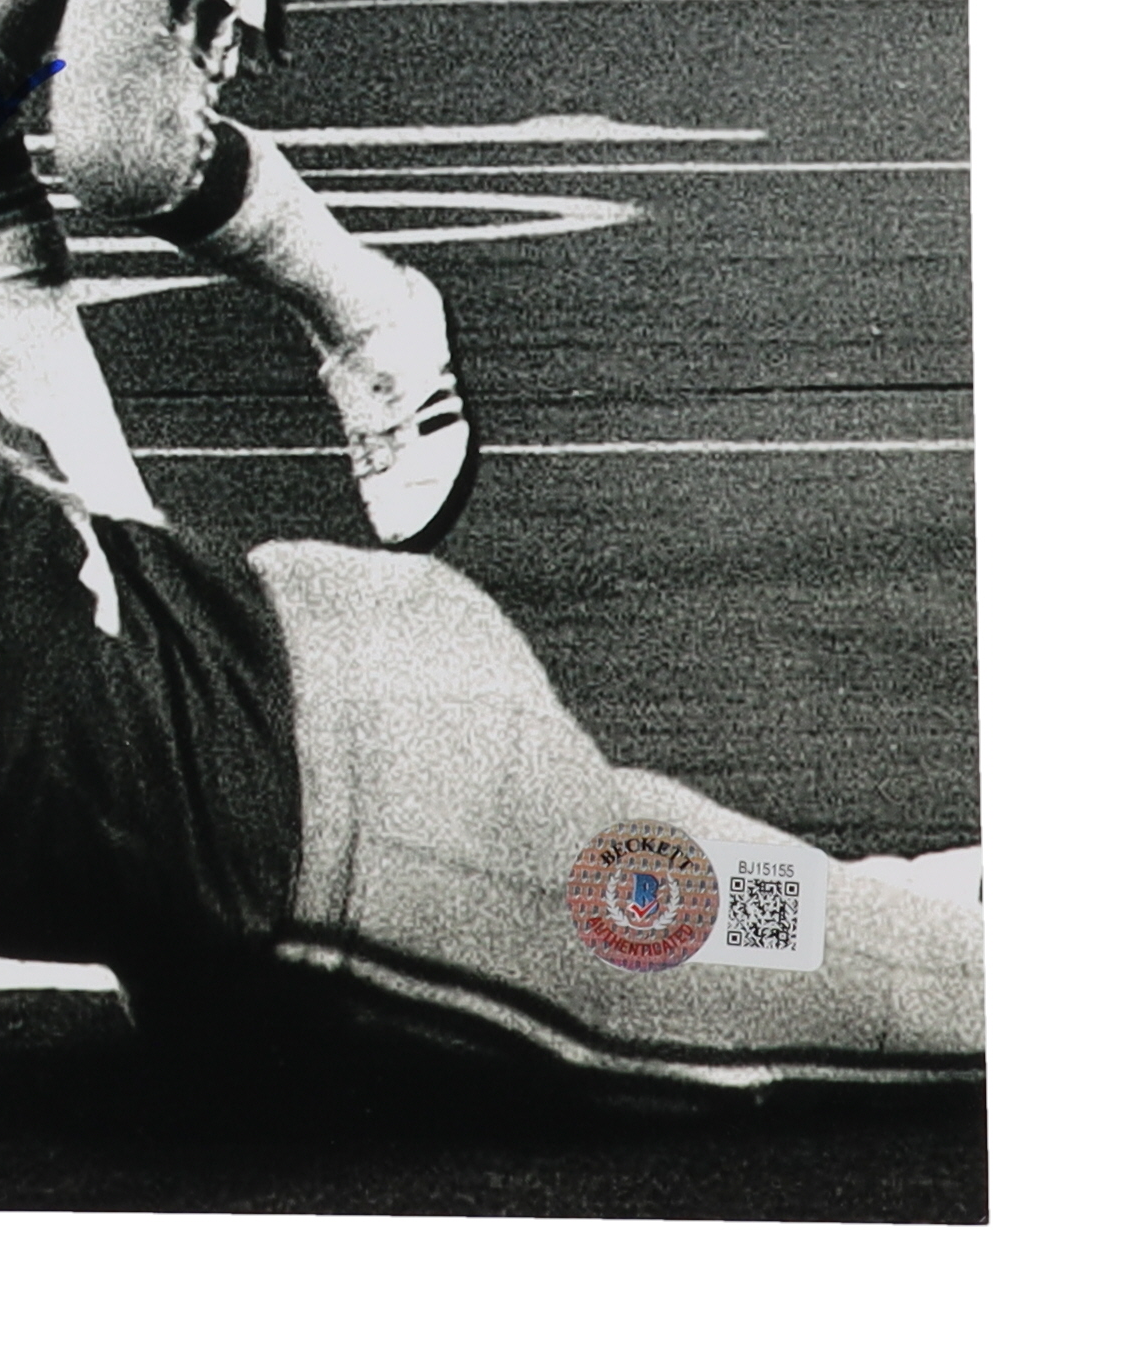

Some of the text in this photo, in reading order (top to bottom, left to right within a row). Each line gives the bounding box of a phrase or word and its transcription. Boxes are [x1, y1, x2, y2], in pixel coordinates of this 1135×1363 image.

[599, 836, 695, 872] BECKETT
[738, 860, 795, 877] BJ15155
[587, 915, 694, 957] AUTHENTICATED
